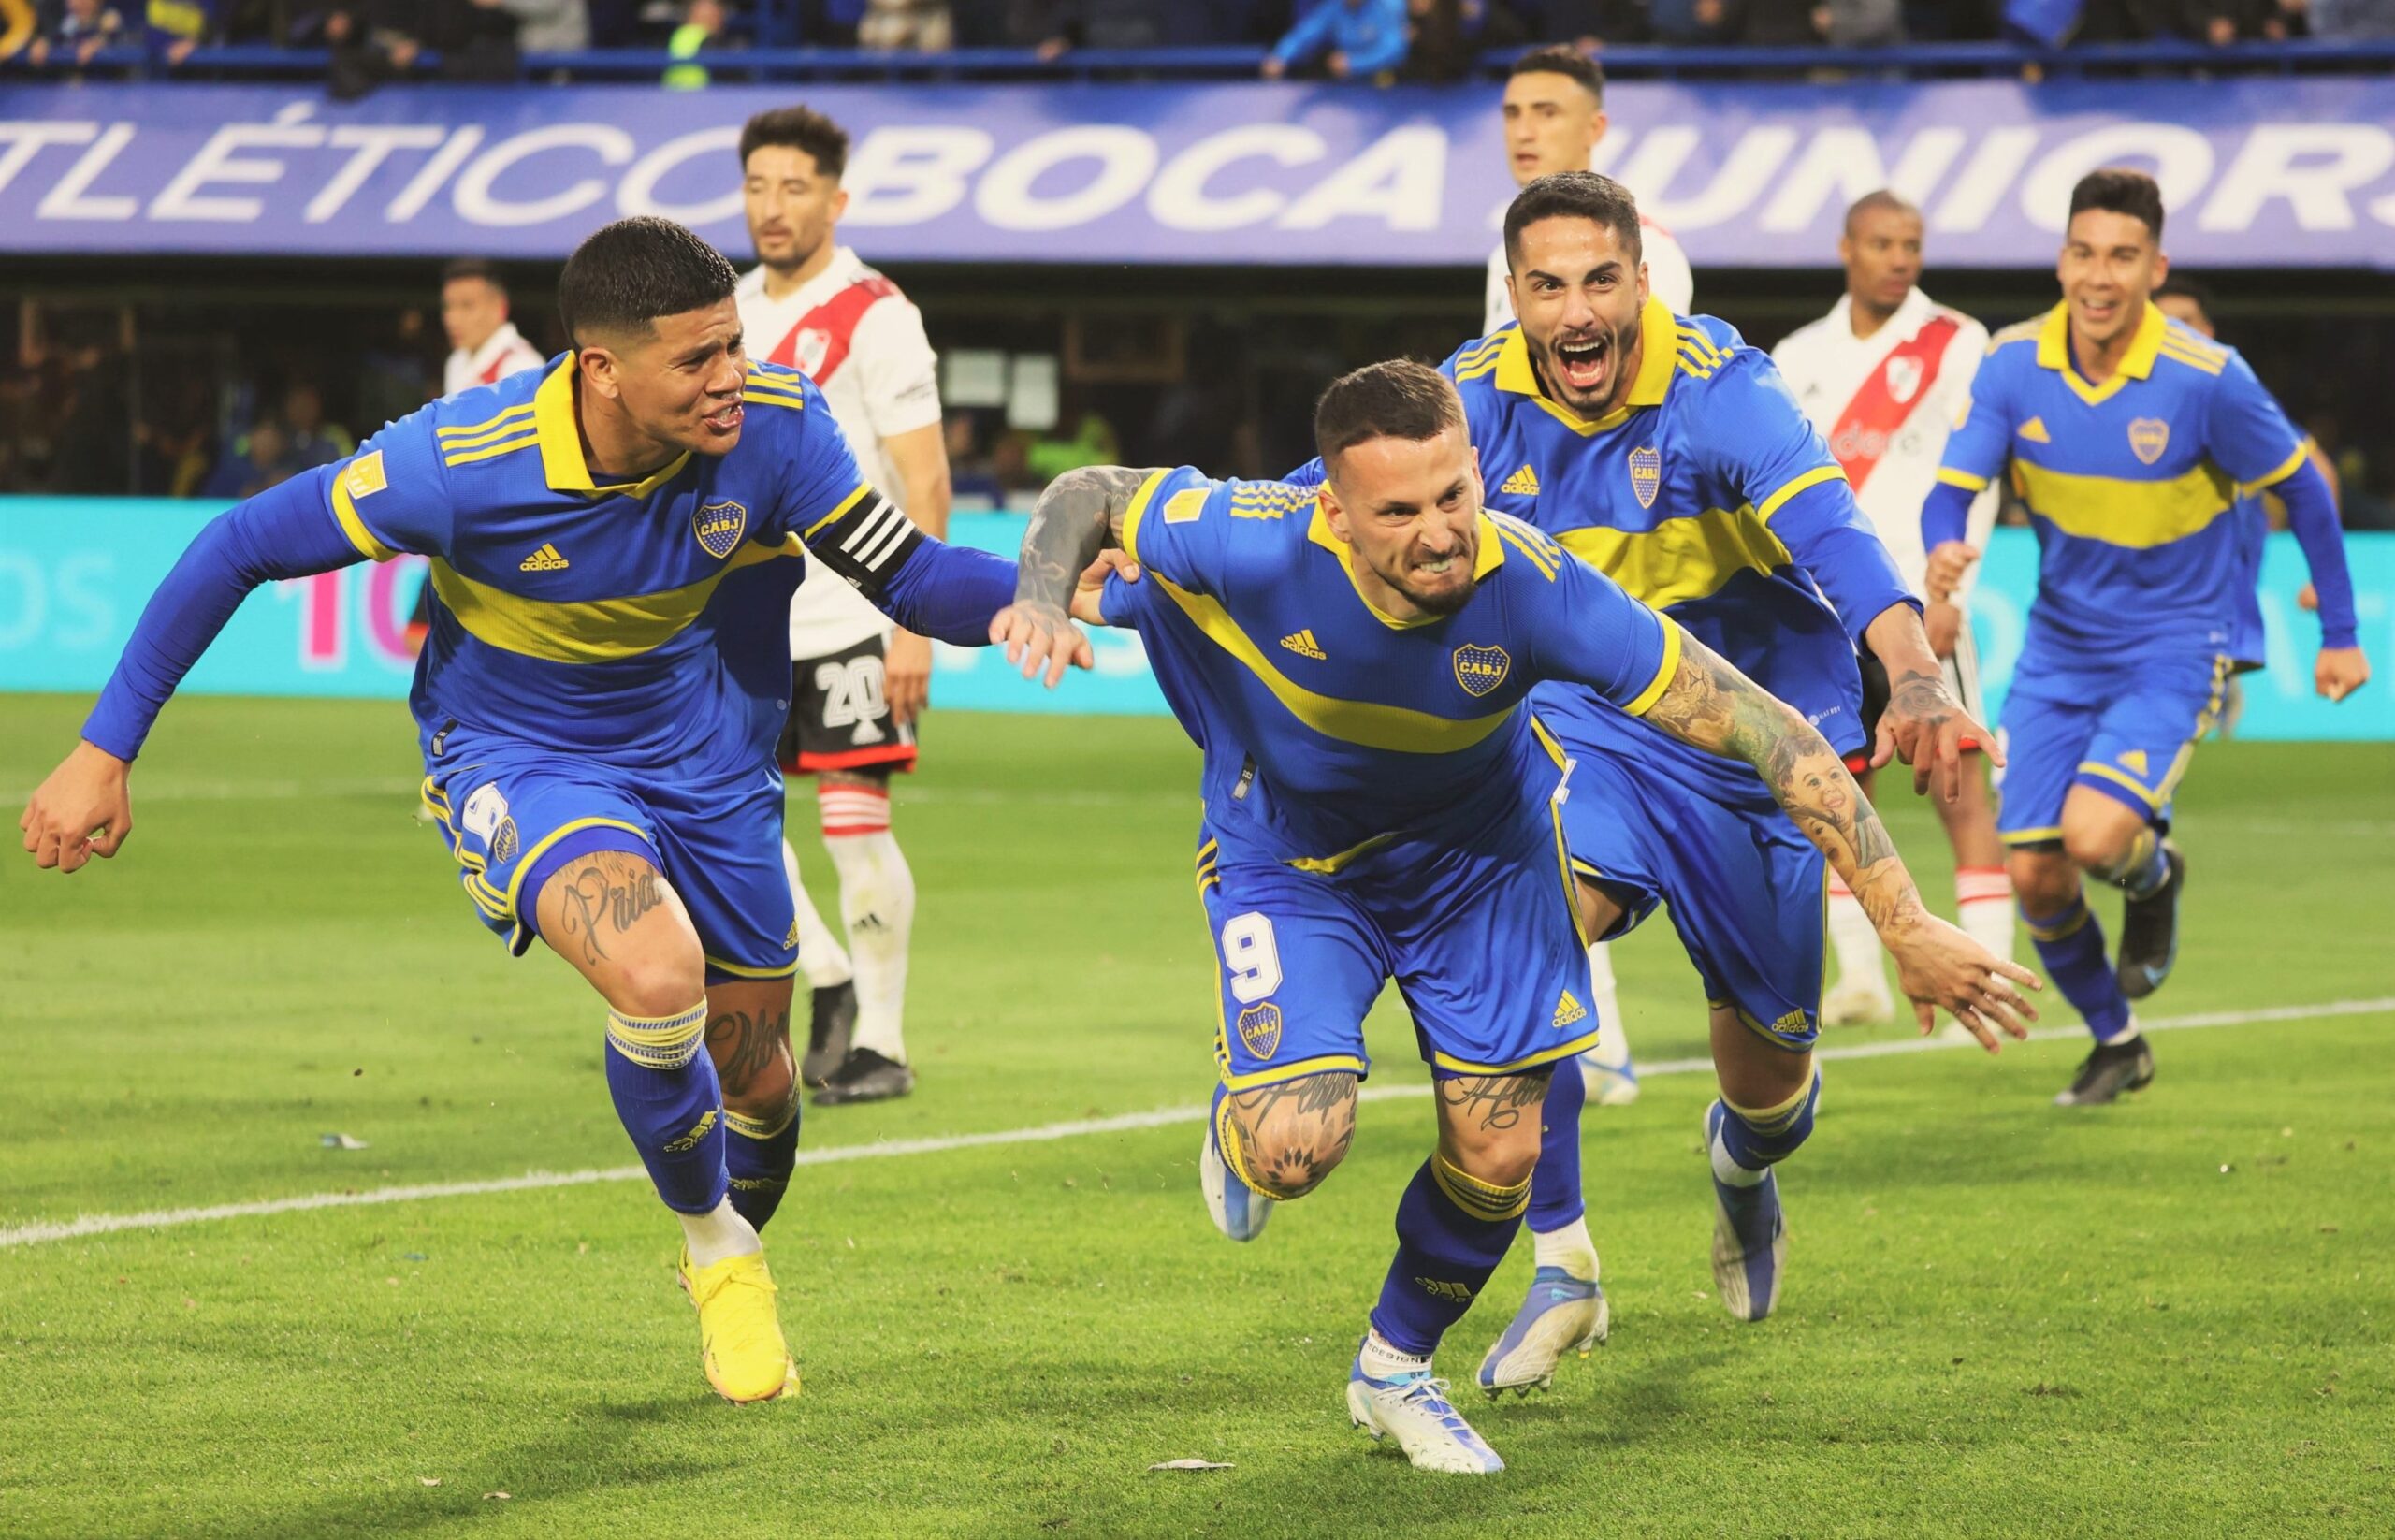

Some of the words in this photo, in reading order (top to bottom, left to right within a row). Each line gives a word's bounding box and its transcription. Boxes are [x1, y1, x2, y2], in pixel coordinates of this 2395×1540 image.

[834, 123, 1449, 233] BOCA
[1488, 122, 2395, 234] UNIOR
[700, 517, 739, 536] CABJ
[519, 558, 569, 572] adidas
[1279, 637, 1327, 661] adidas
[1459, 661, 1502, 676] CABJ
[815, 654, 890, 729] 20
[1221, 910, 1284, 1004] 9
[1551, 1007, 1588, 1028] adidas
[1245, 1020, 1277, 1039] CABJ
[1771, 1023, 1809, 1033] adidas
